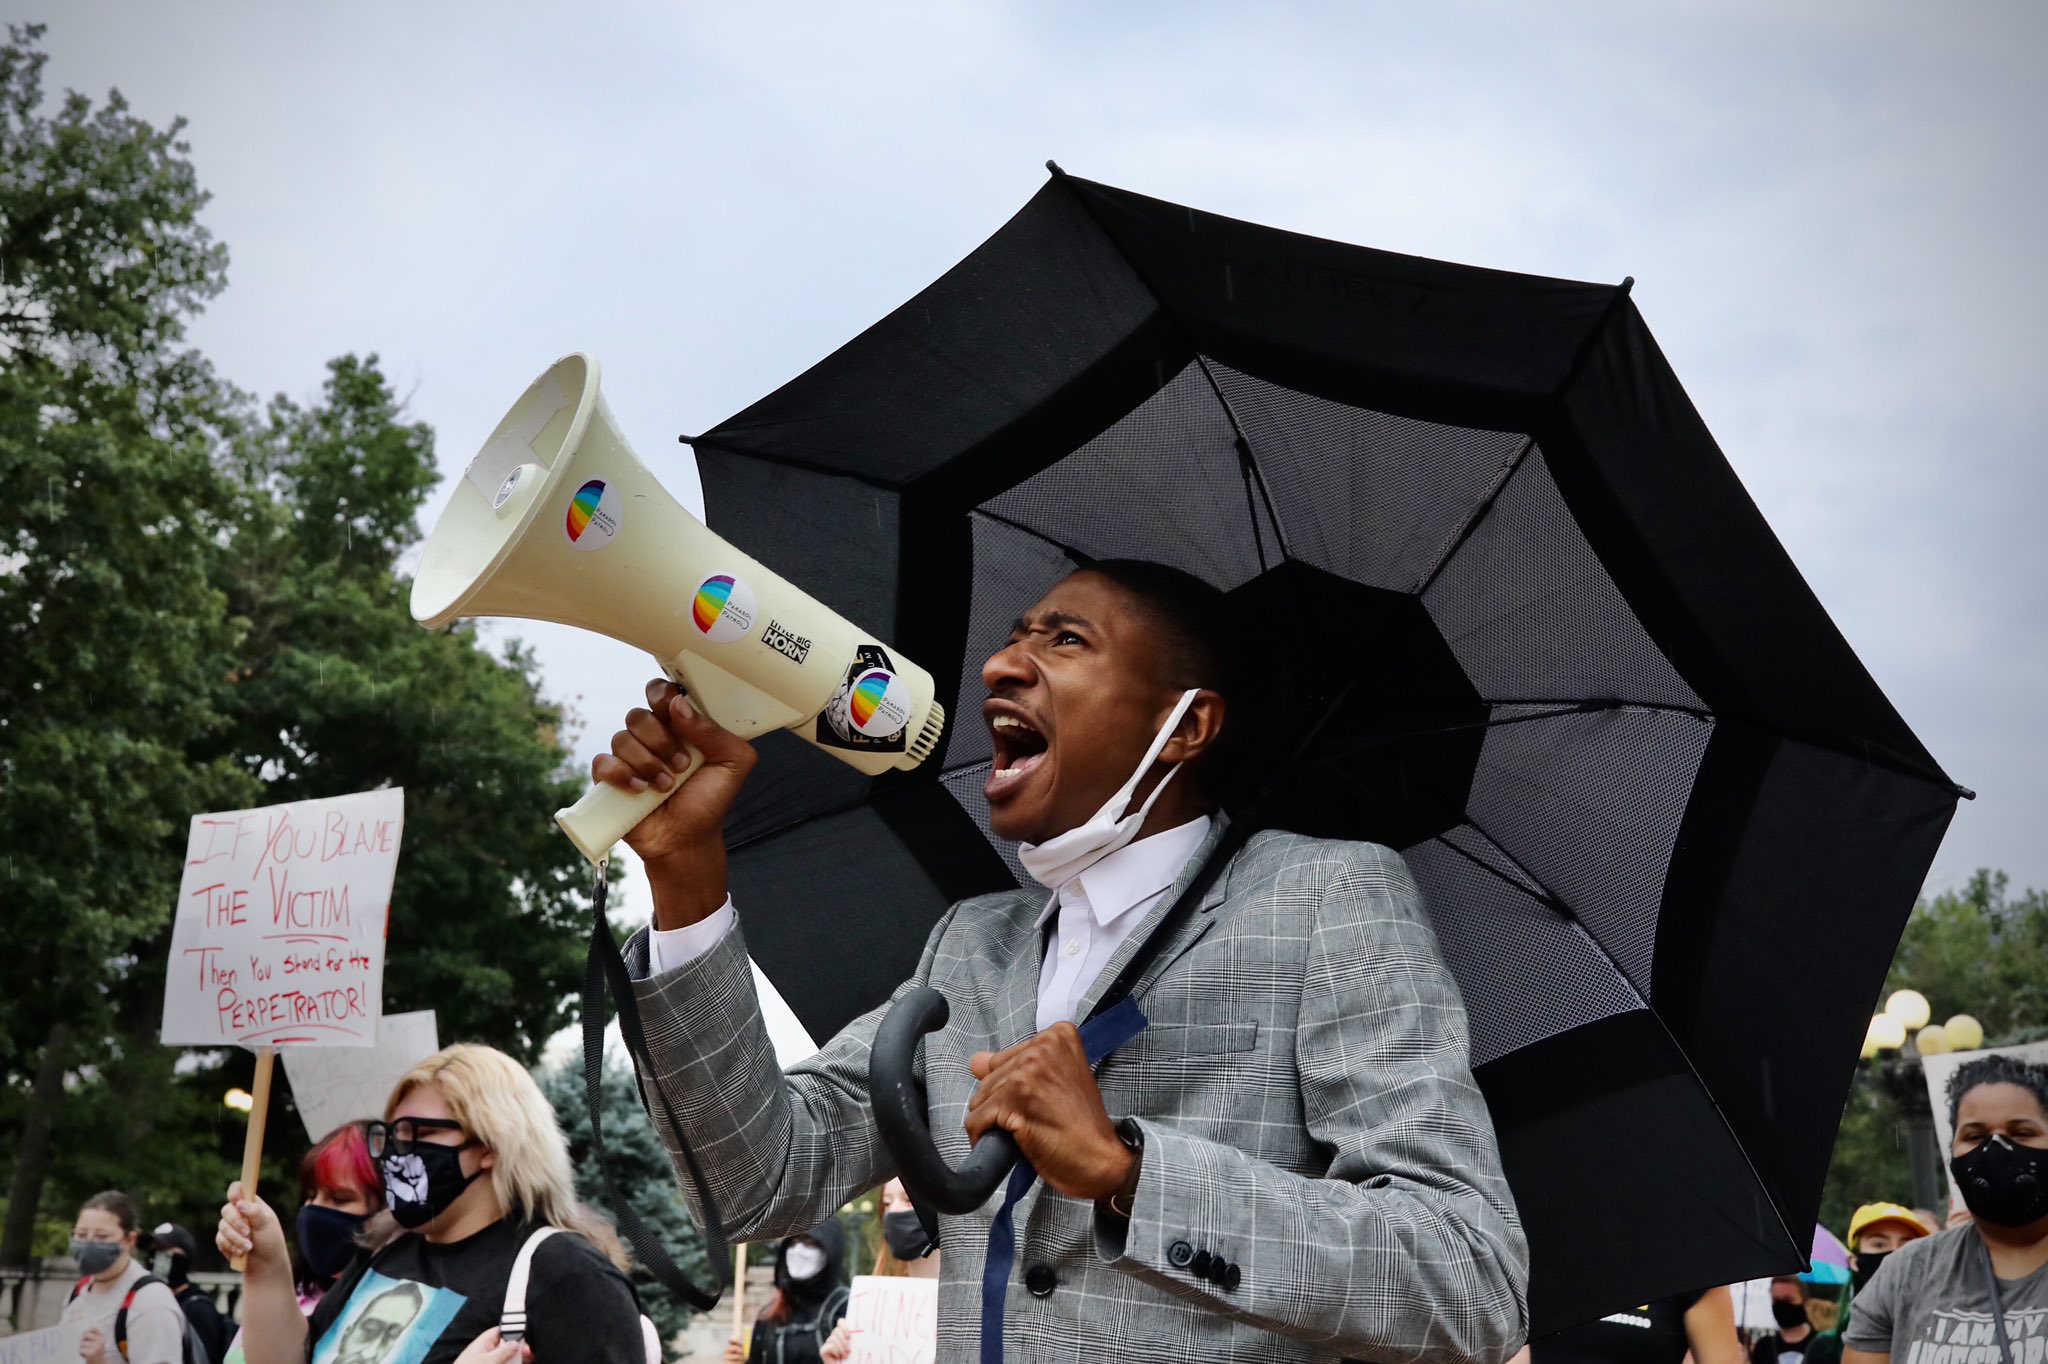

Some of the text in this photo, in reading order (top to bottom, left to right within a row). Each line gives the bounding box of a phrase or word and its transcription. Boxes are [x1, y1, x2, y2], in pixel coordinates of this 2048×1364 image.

[722, 610, 744, 628] PATROL
[727, 601, 753, 620] PARASOL
[762, 627, 808, 663] HORN
[796, 635, 812, 649] BIG
[879, 706, 899, 723] PATROL
[883, 697, 906, 715] PARASOL
[189, 811, 396, 880] IF YOU BLAME
[192, 866, 350, 930] THE VICTIM
[184, 947, 237, 991] Then
[326, 948, 343, 972] for
[217, 981, 366, 1035] PERPETRATOR!
[1935, 1313, 2045, 1346] I AM MY
